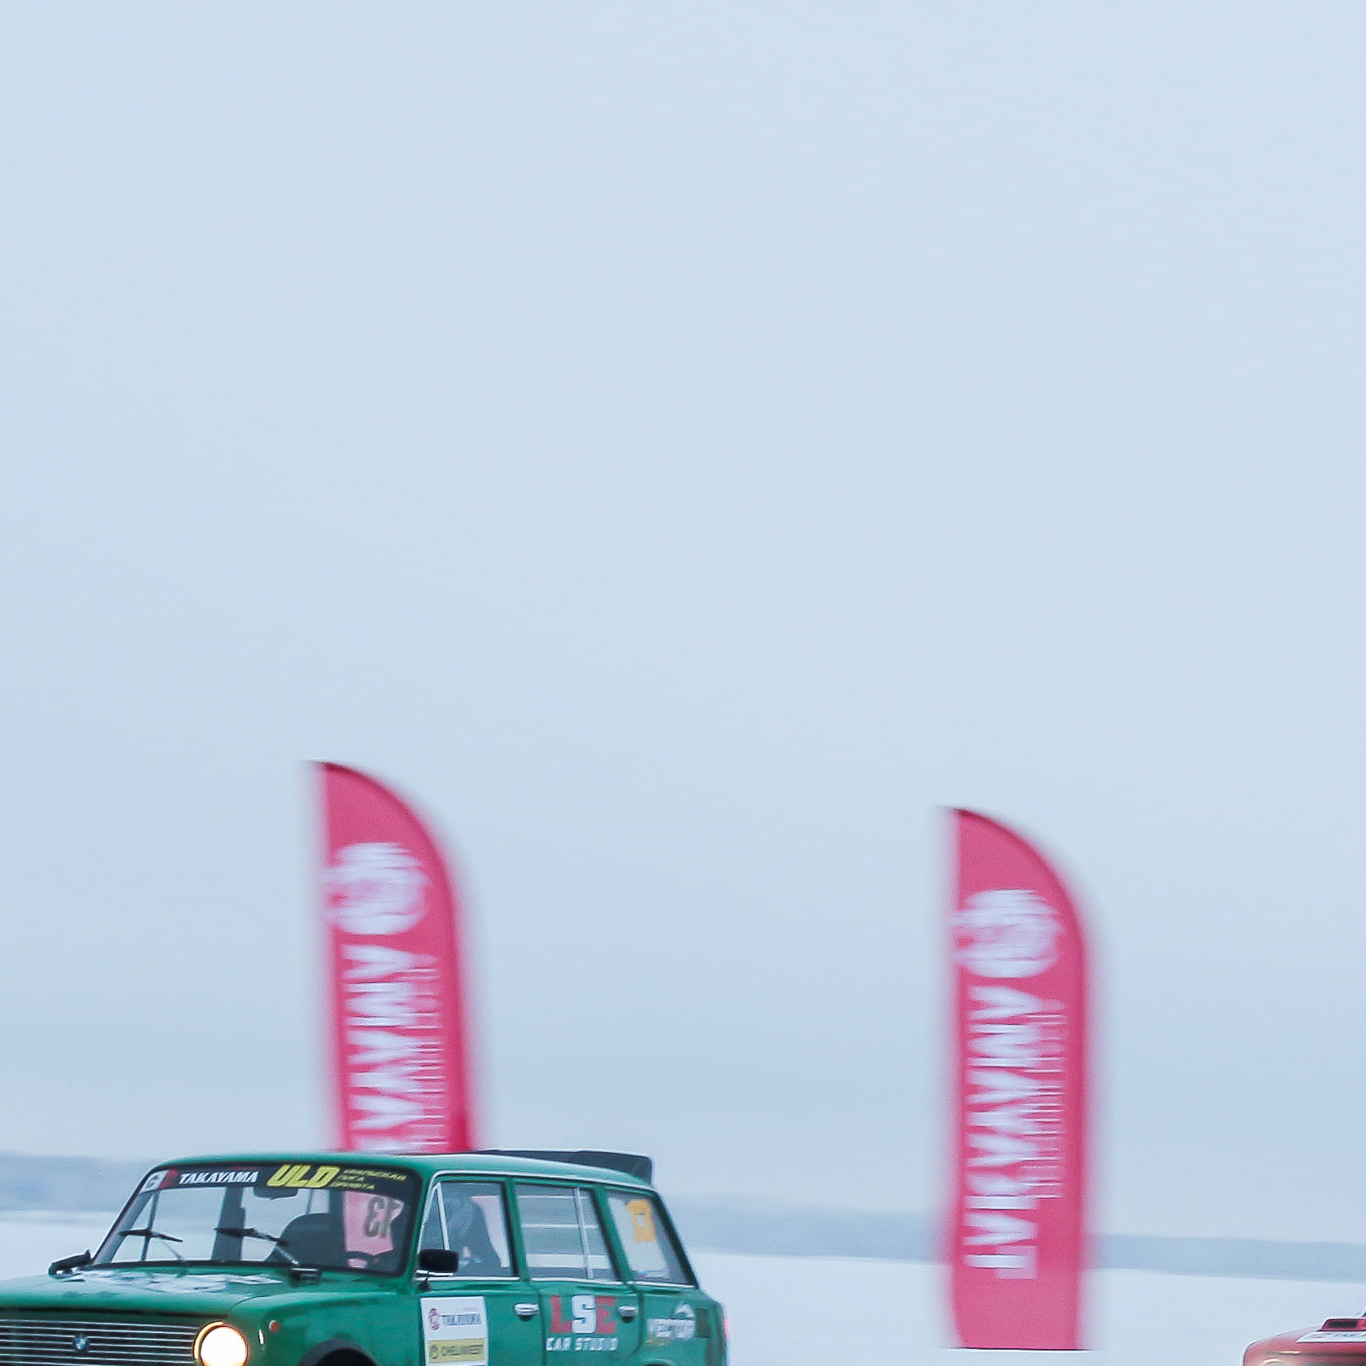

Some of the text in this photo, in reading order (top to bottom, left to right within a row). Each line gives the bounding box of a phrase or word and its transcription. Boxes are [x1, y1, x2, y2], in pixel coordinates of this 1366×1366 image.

[178, 1171, 259, 1185] TAKAYAMA
[266, 1164, 341, 1189] ULD
[549, 1294, 618, 1334] LSE
[546, 1336, 619, 1351] CAR STUDIO
